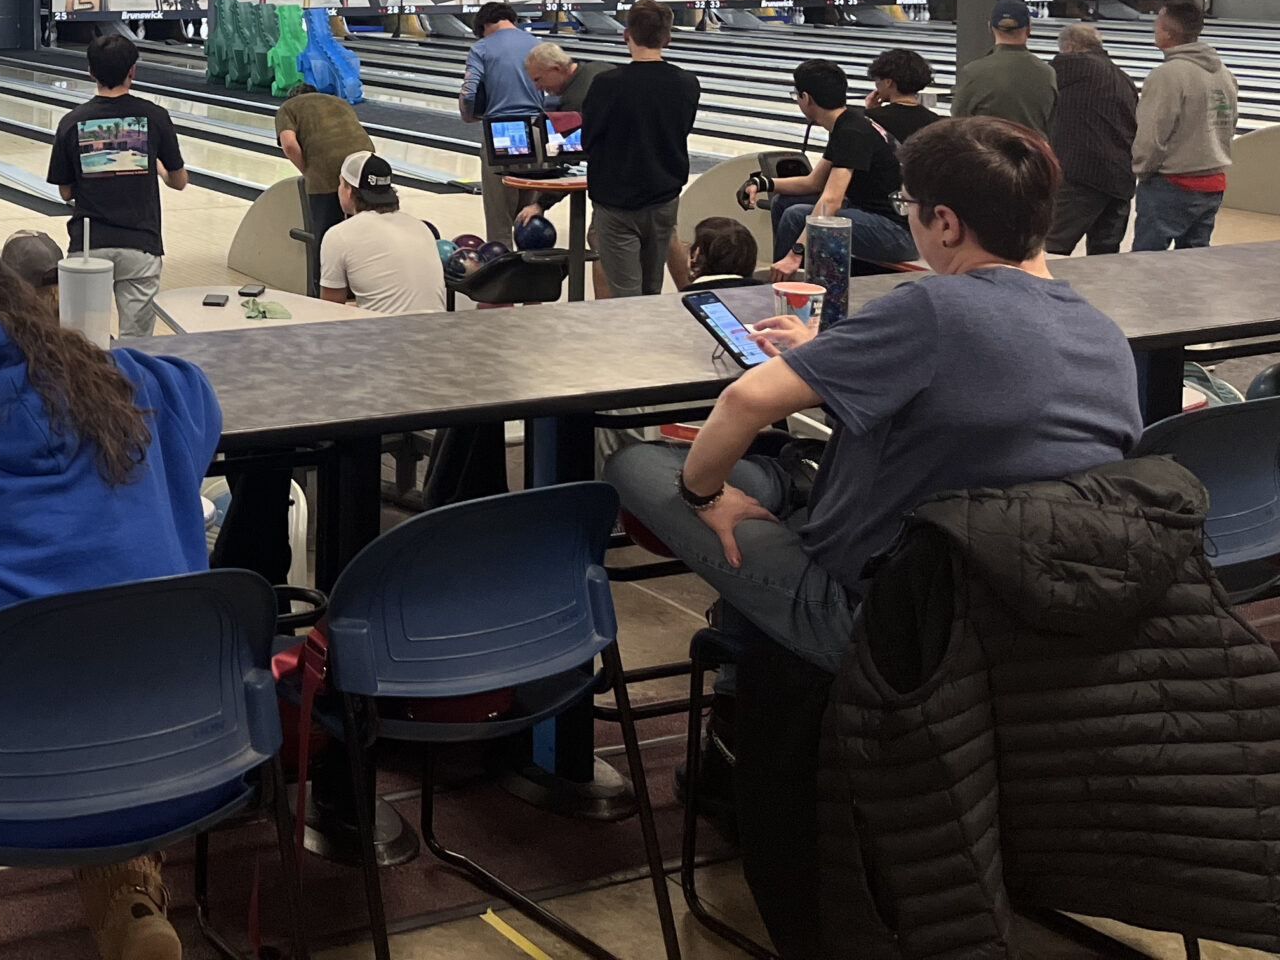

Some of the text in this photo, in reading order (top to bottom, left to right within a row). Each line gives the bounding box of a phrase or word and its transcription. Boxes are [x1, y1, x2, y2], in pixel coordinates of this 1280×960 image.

[546, 3, 558, 11] 30
[562, 3, 572, 11] 31
[695, 1, 706, 9] 32
[710, 1, 721, 9] 33
[387, 6, 399, 14] 28
[404, 6, 416, 14] 29
[54, 12, 67, 20] 25
[121, 10, 163, 20] Brunswick
